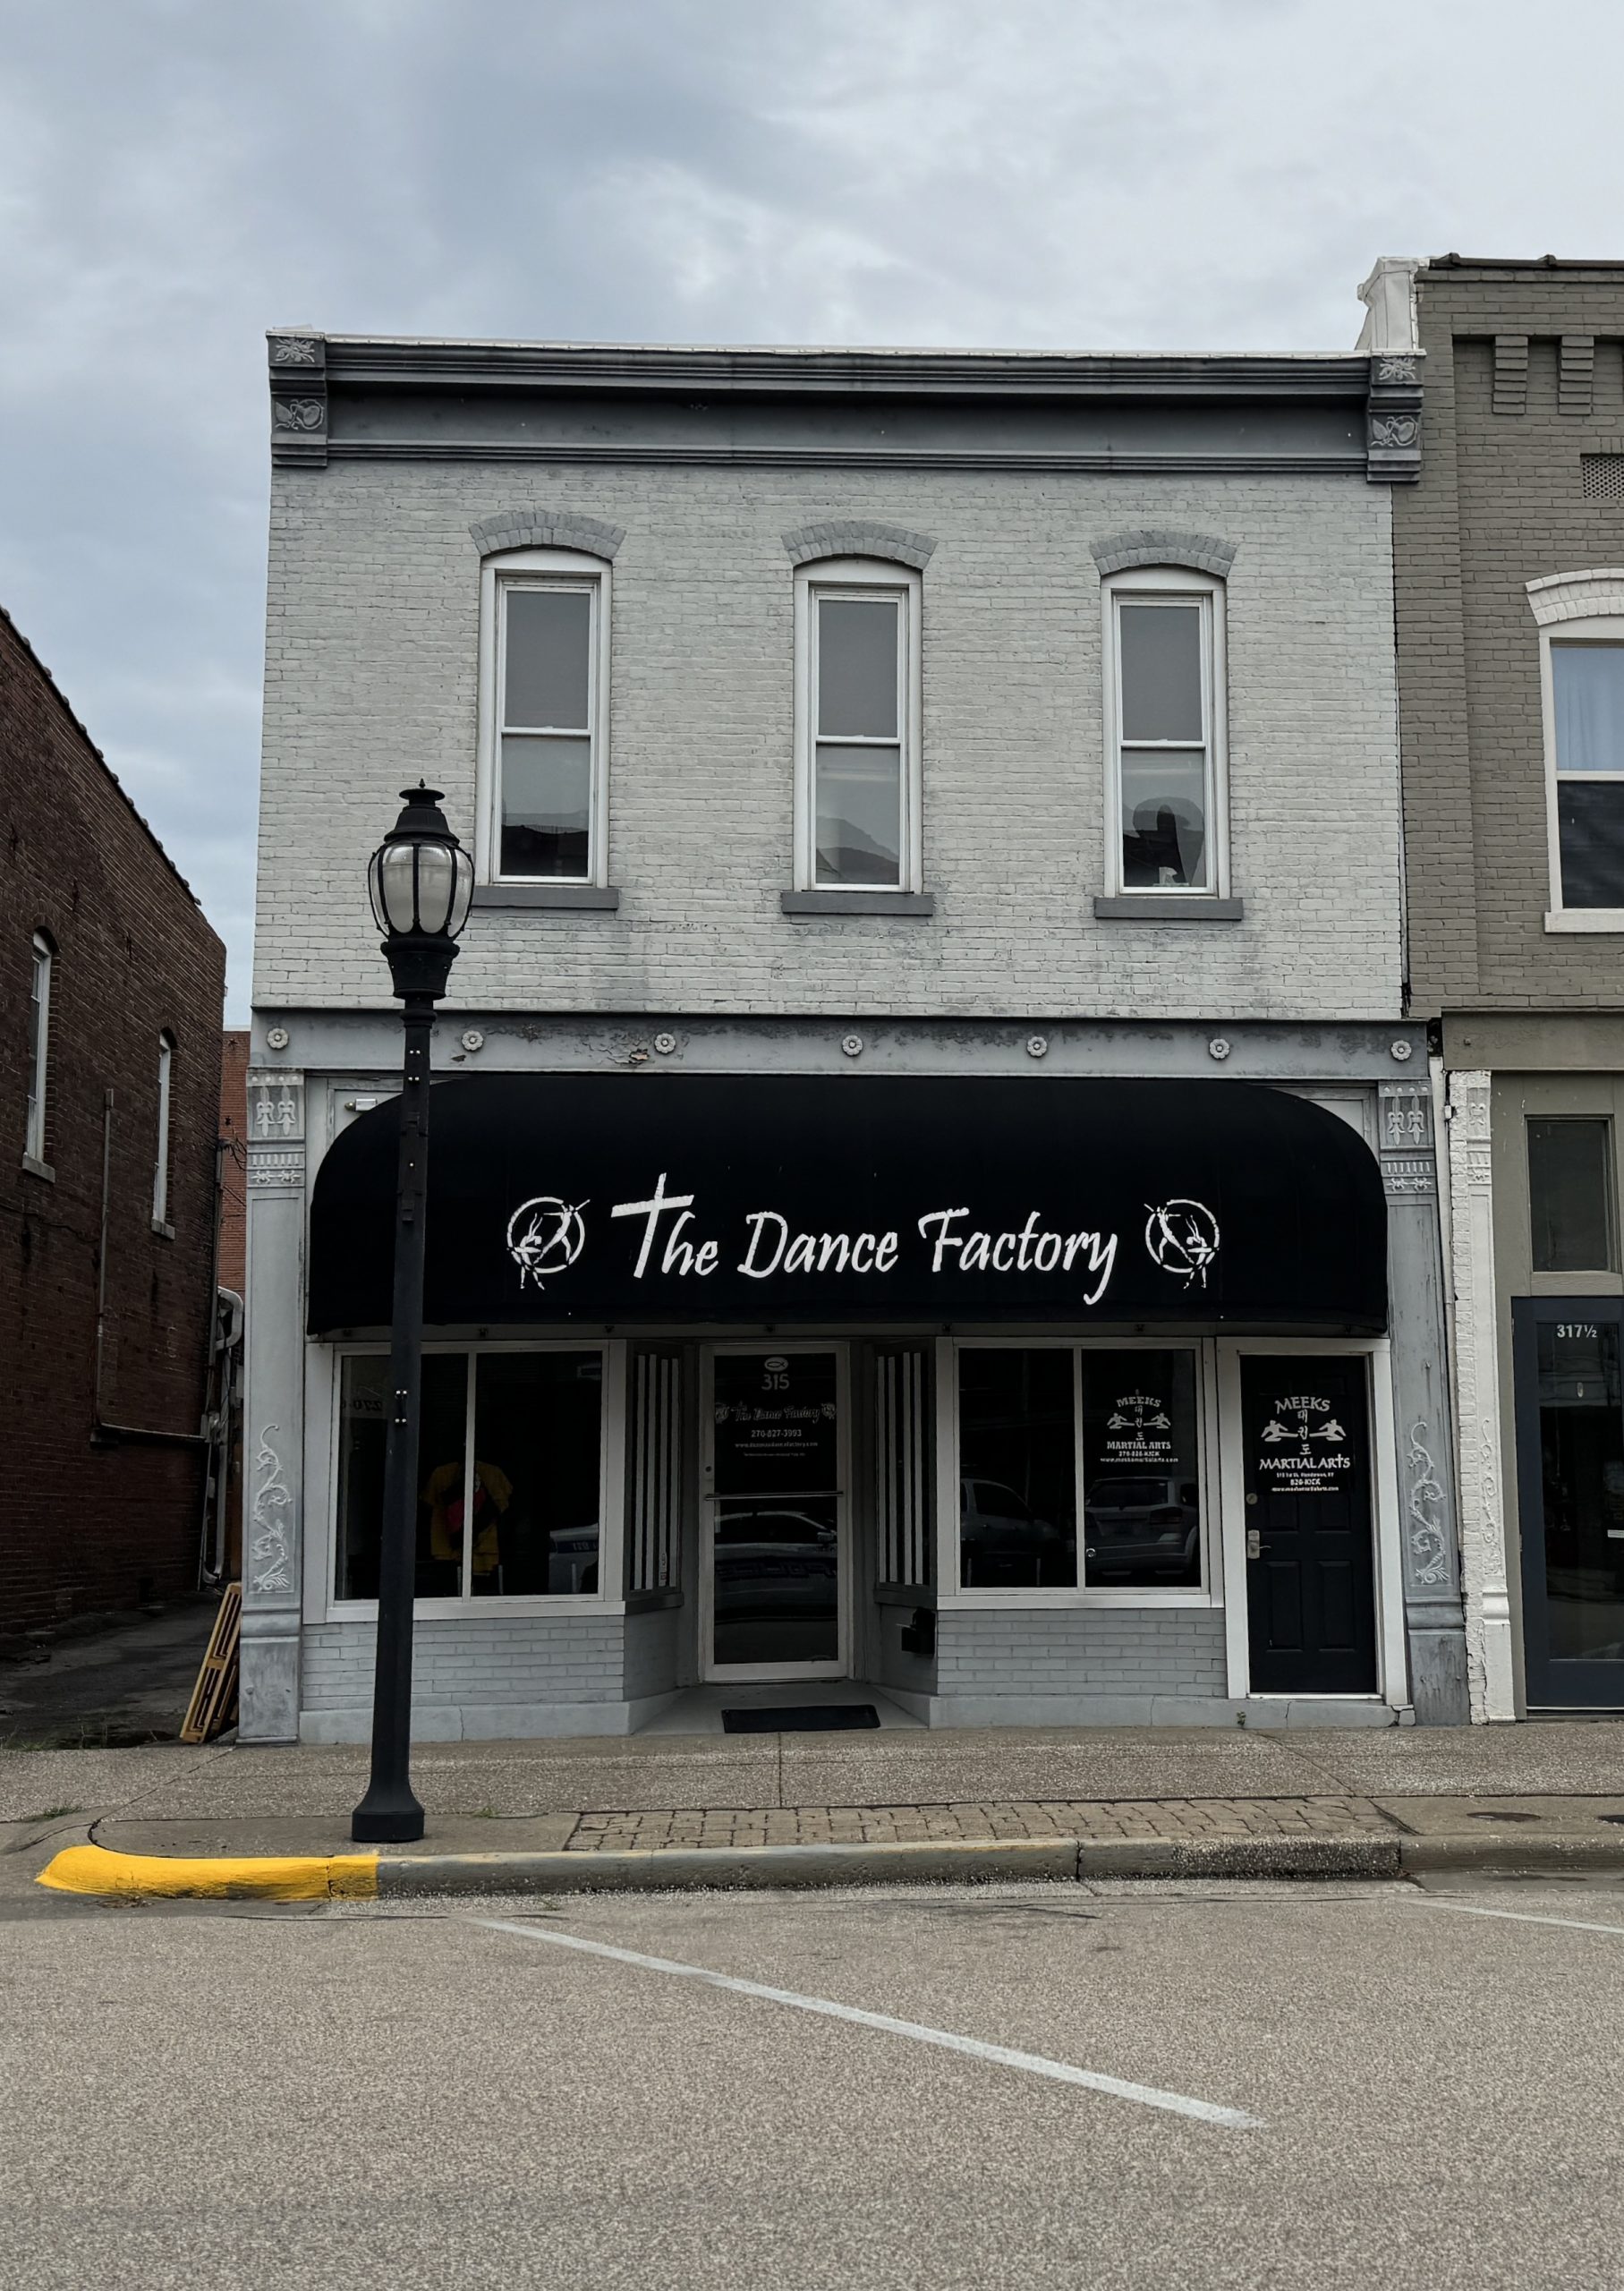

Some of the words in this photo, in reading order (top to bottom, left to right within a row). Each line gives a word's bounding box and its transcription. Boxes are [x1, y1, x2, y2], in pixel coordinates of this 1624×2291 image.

[610, 1172, 719, 1279] The
[736, 1211, 899, 1279] Dance
[917, 1206, 1118, 1306] Factory
[761, 1373, 790, 1391] 315
[1116, 1396, 1162, 1409] MEEKS
[1274, 1396, 1331, 1415] MEEKS
[1106, 1441, 1147, 1450] MARTIAL
[1148, 1441, 1171, 1450] ARTS
[1259, 1457, 1317, 1470] MARTIAL
